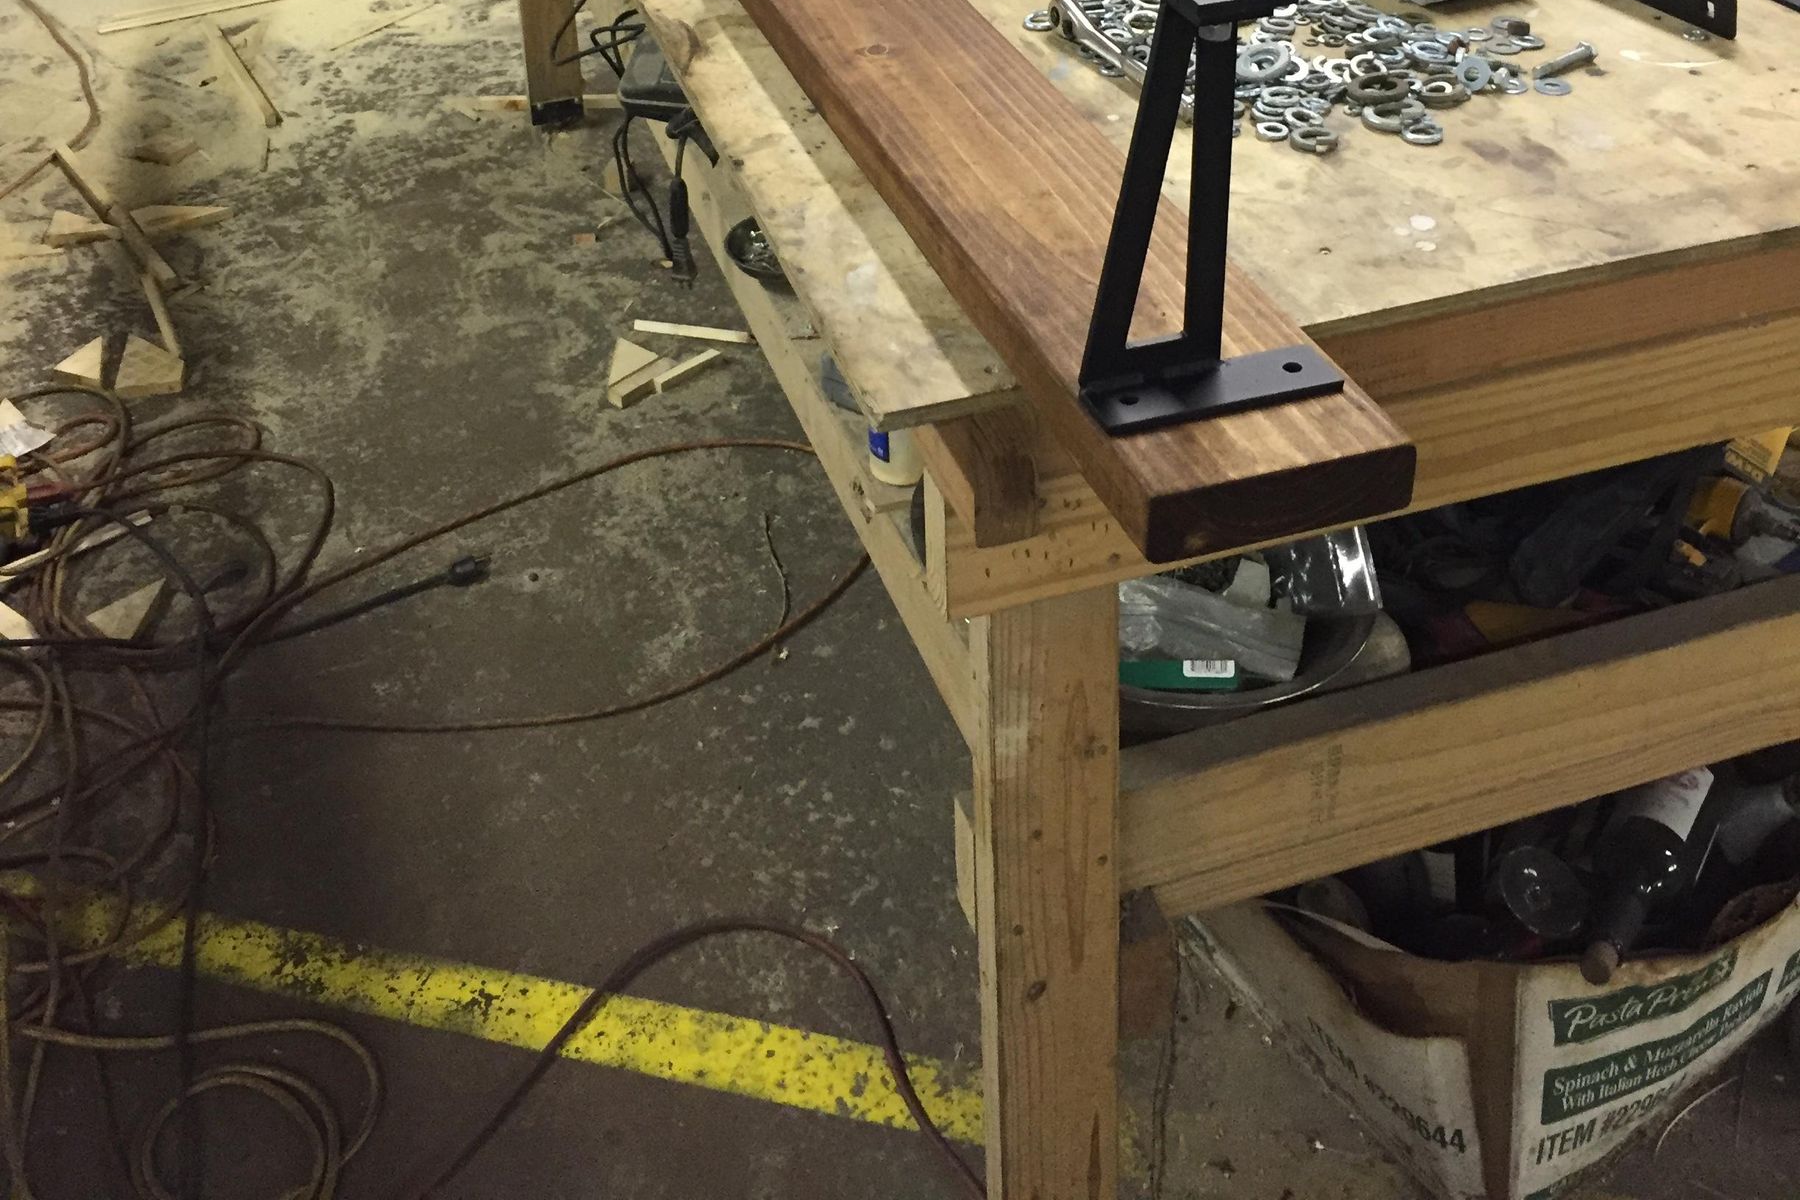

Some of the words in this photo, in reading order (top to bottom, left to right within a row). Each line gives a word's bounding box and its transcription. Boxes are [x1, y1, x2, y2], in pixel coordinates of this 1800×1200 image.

[1565, 994, 1643, 1038] Pasta
[1553, 1061, 1619, 1096] Spinach
[1624, 1054, 1638, 1072] &
[1561, 1090, 1595, 1112] With
[1598, 1074, 1642, 1099] Italian
[1645, 1058, 1678, 1081] Herb
[1536, 1117, 1597, 1165] ITEM
